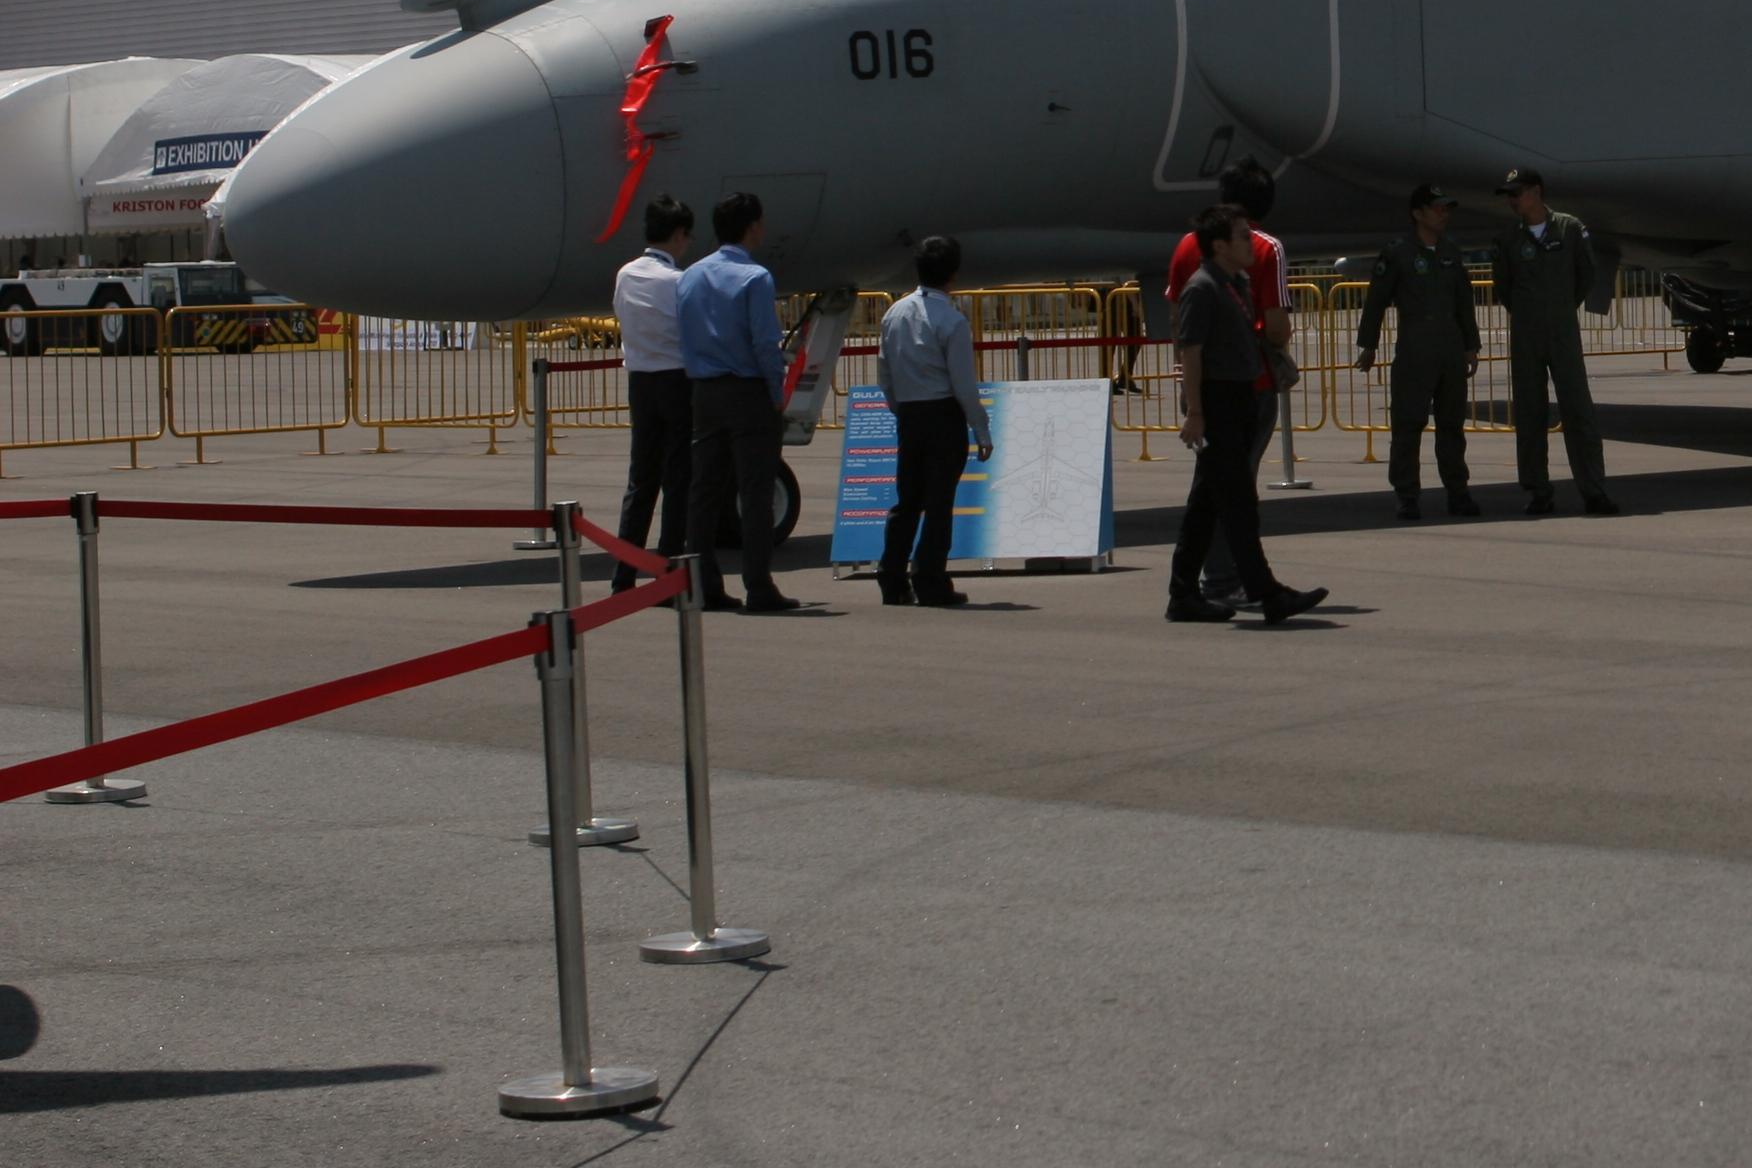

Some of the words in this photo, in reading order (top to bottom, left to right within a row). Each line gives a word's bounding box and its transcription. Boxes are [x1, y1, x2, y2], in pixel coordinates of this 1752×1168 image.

[849, 29, 934, 80] 016
[167, 139, 244, 167] EXHIBITION
[112, 199, 176, 213] KRISTON
